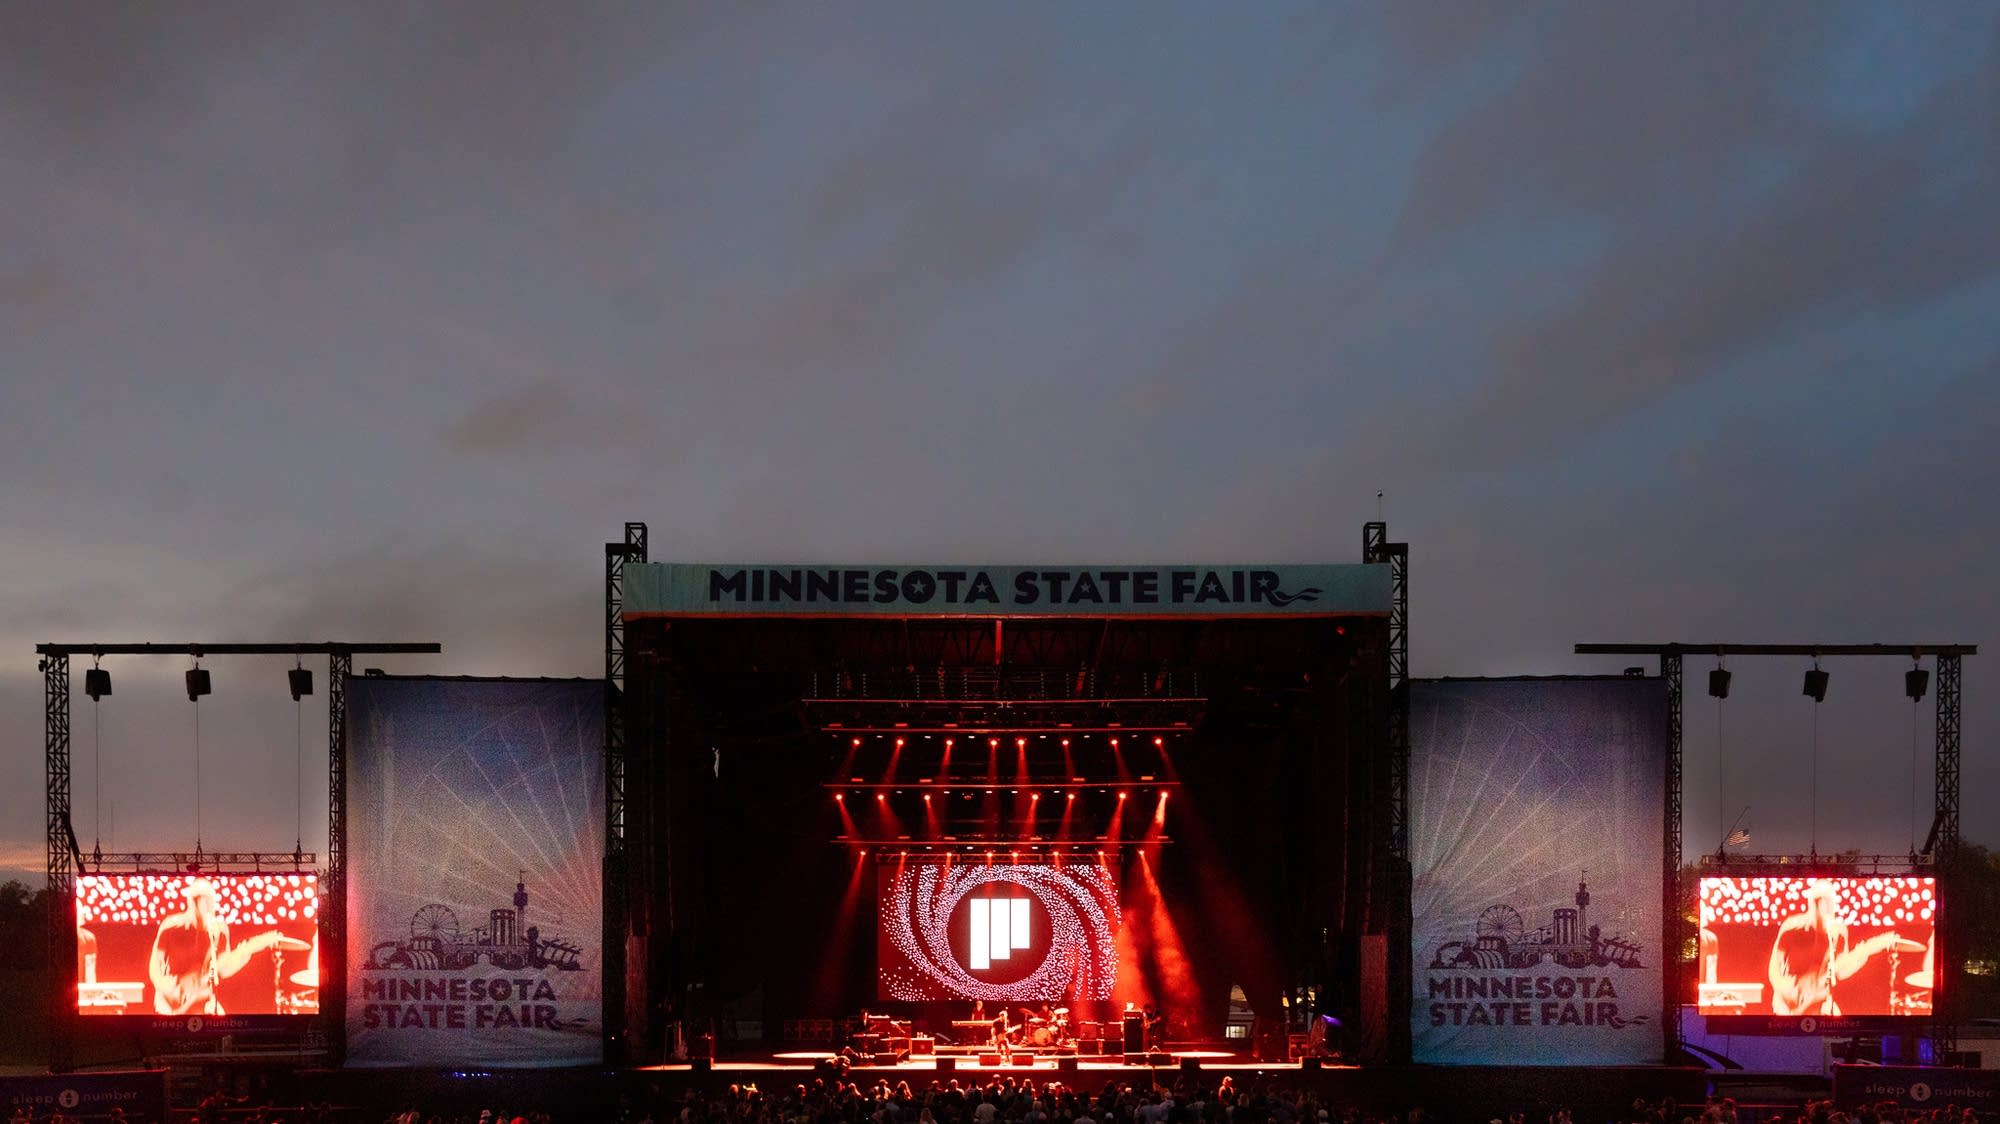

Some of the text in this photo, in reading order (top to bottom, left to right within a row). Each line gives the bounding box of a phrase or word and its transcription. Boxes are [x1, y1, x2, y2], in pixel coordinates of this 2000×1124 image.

[709, 570, 1287, 606] MINNESOTA STATE FAIR
[362, 978, 557, 1001] MINNESOTA
[1429, 977, 1618, 999] MINNESOTA
[205, 1018, 249, 1028] number
[363, 1004, 562, 1030] STATE FAIR
[1430, 1002, 1626, 1029] STATE FAIR
[10, 1091, 139, 1105] sleep number
[1864, 1083, 1993, 1098] sleep number
